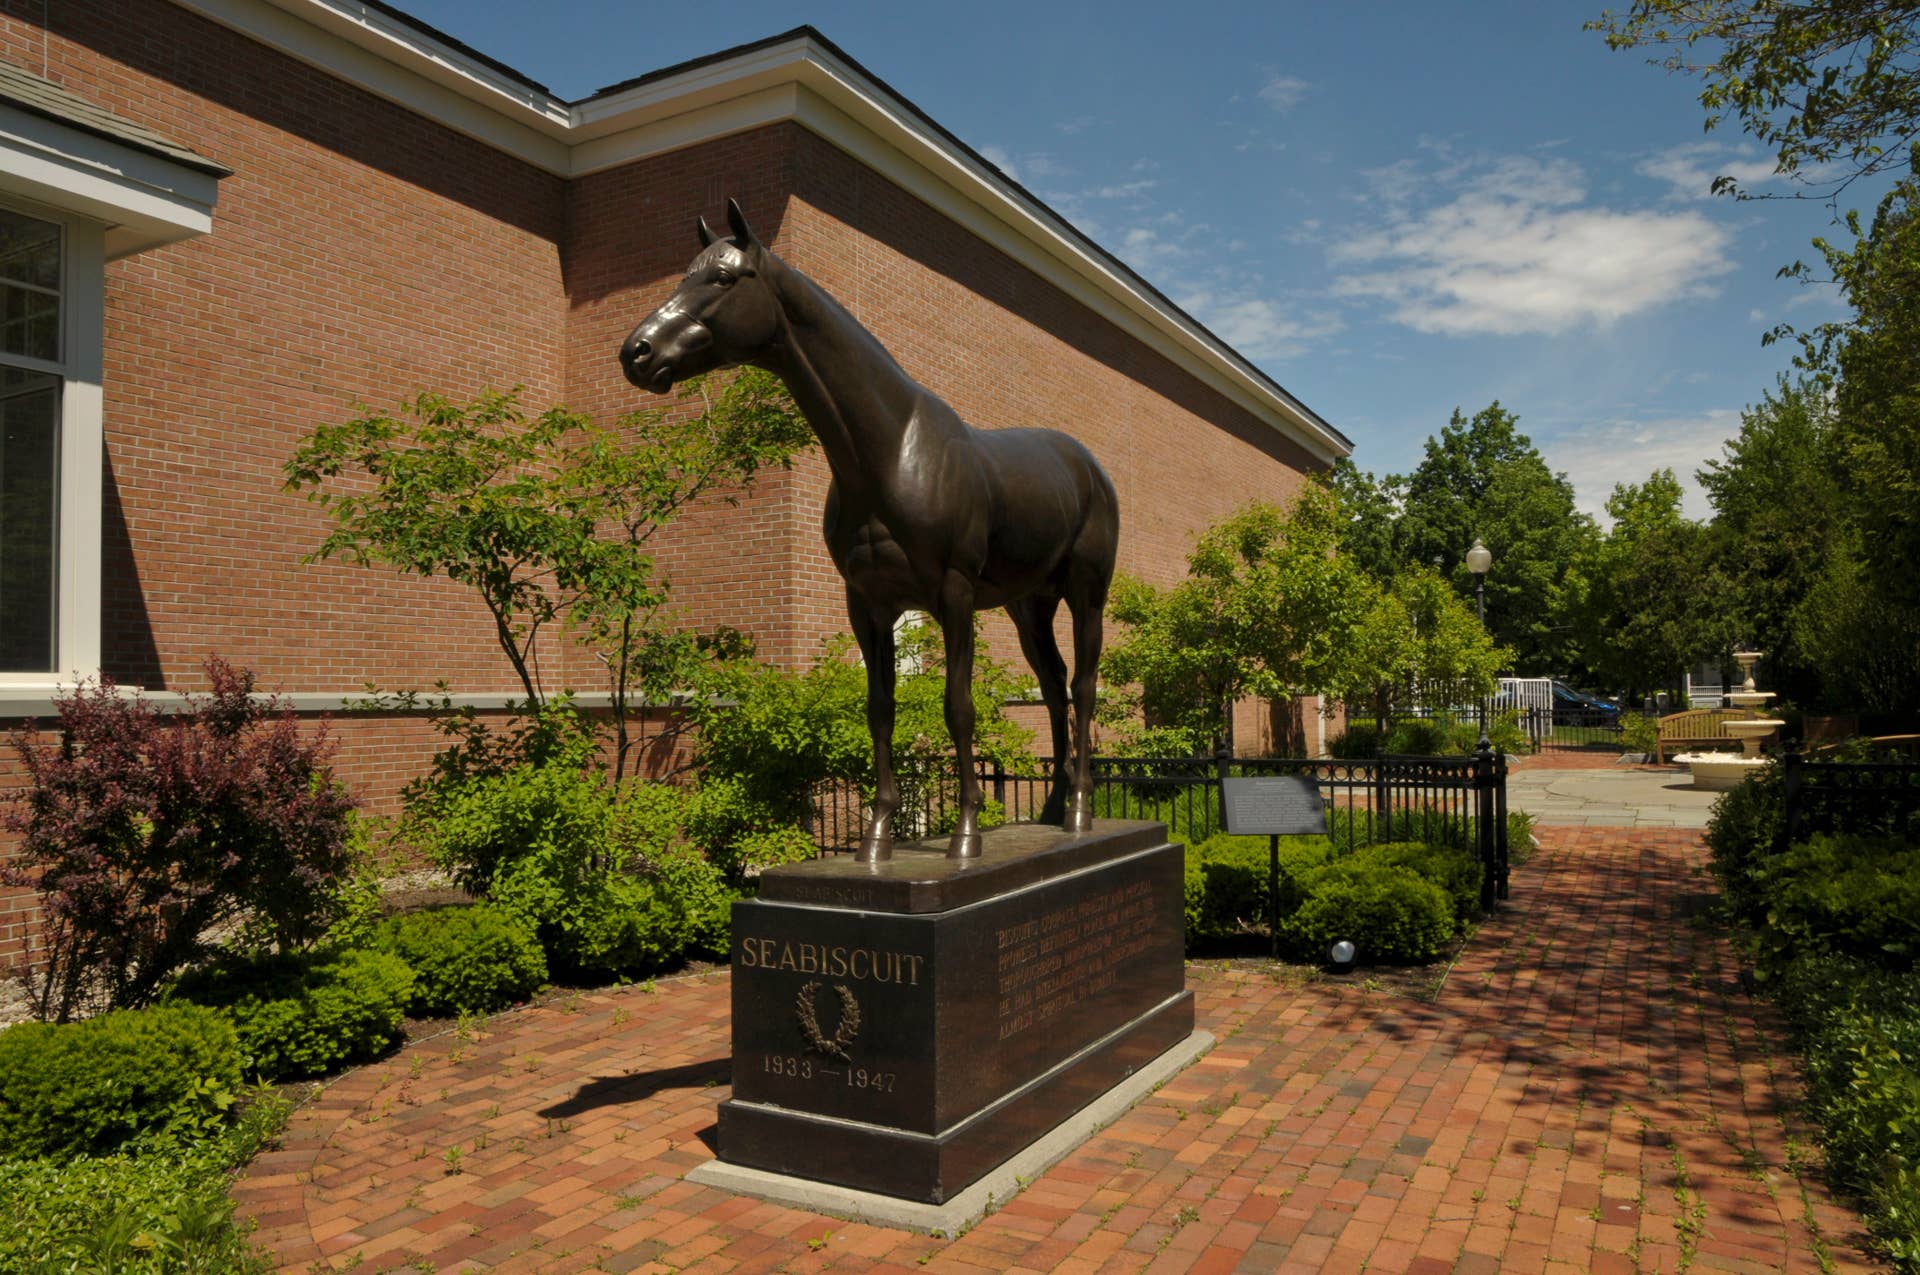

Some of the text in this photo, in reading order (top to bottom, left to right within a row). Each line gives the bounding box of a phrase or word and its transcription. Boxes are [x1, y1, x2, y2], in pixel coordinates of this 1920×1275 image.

[741, 936, 924, 985] SEABISCUIT
[763, 1054, 813, 1080] 1933
[847, 1068, 897, 1092] 1947
